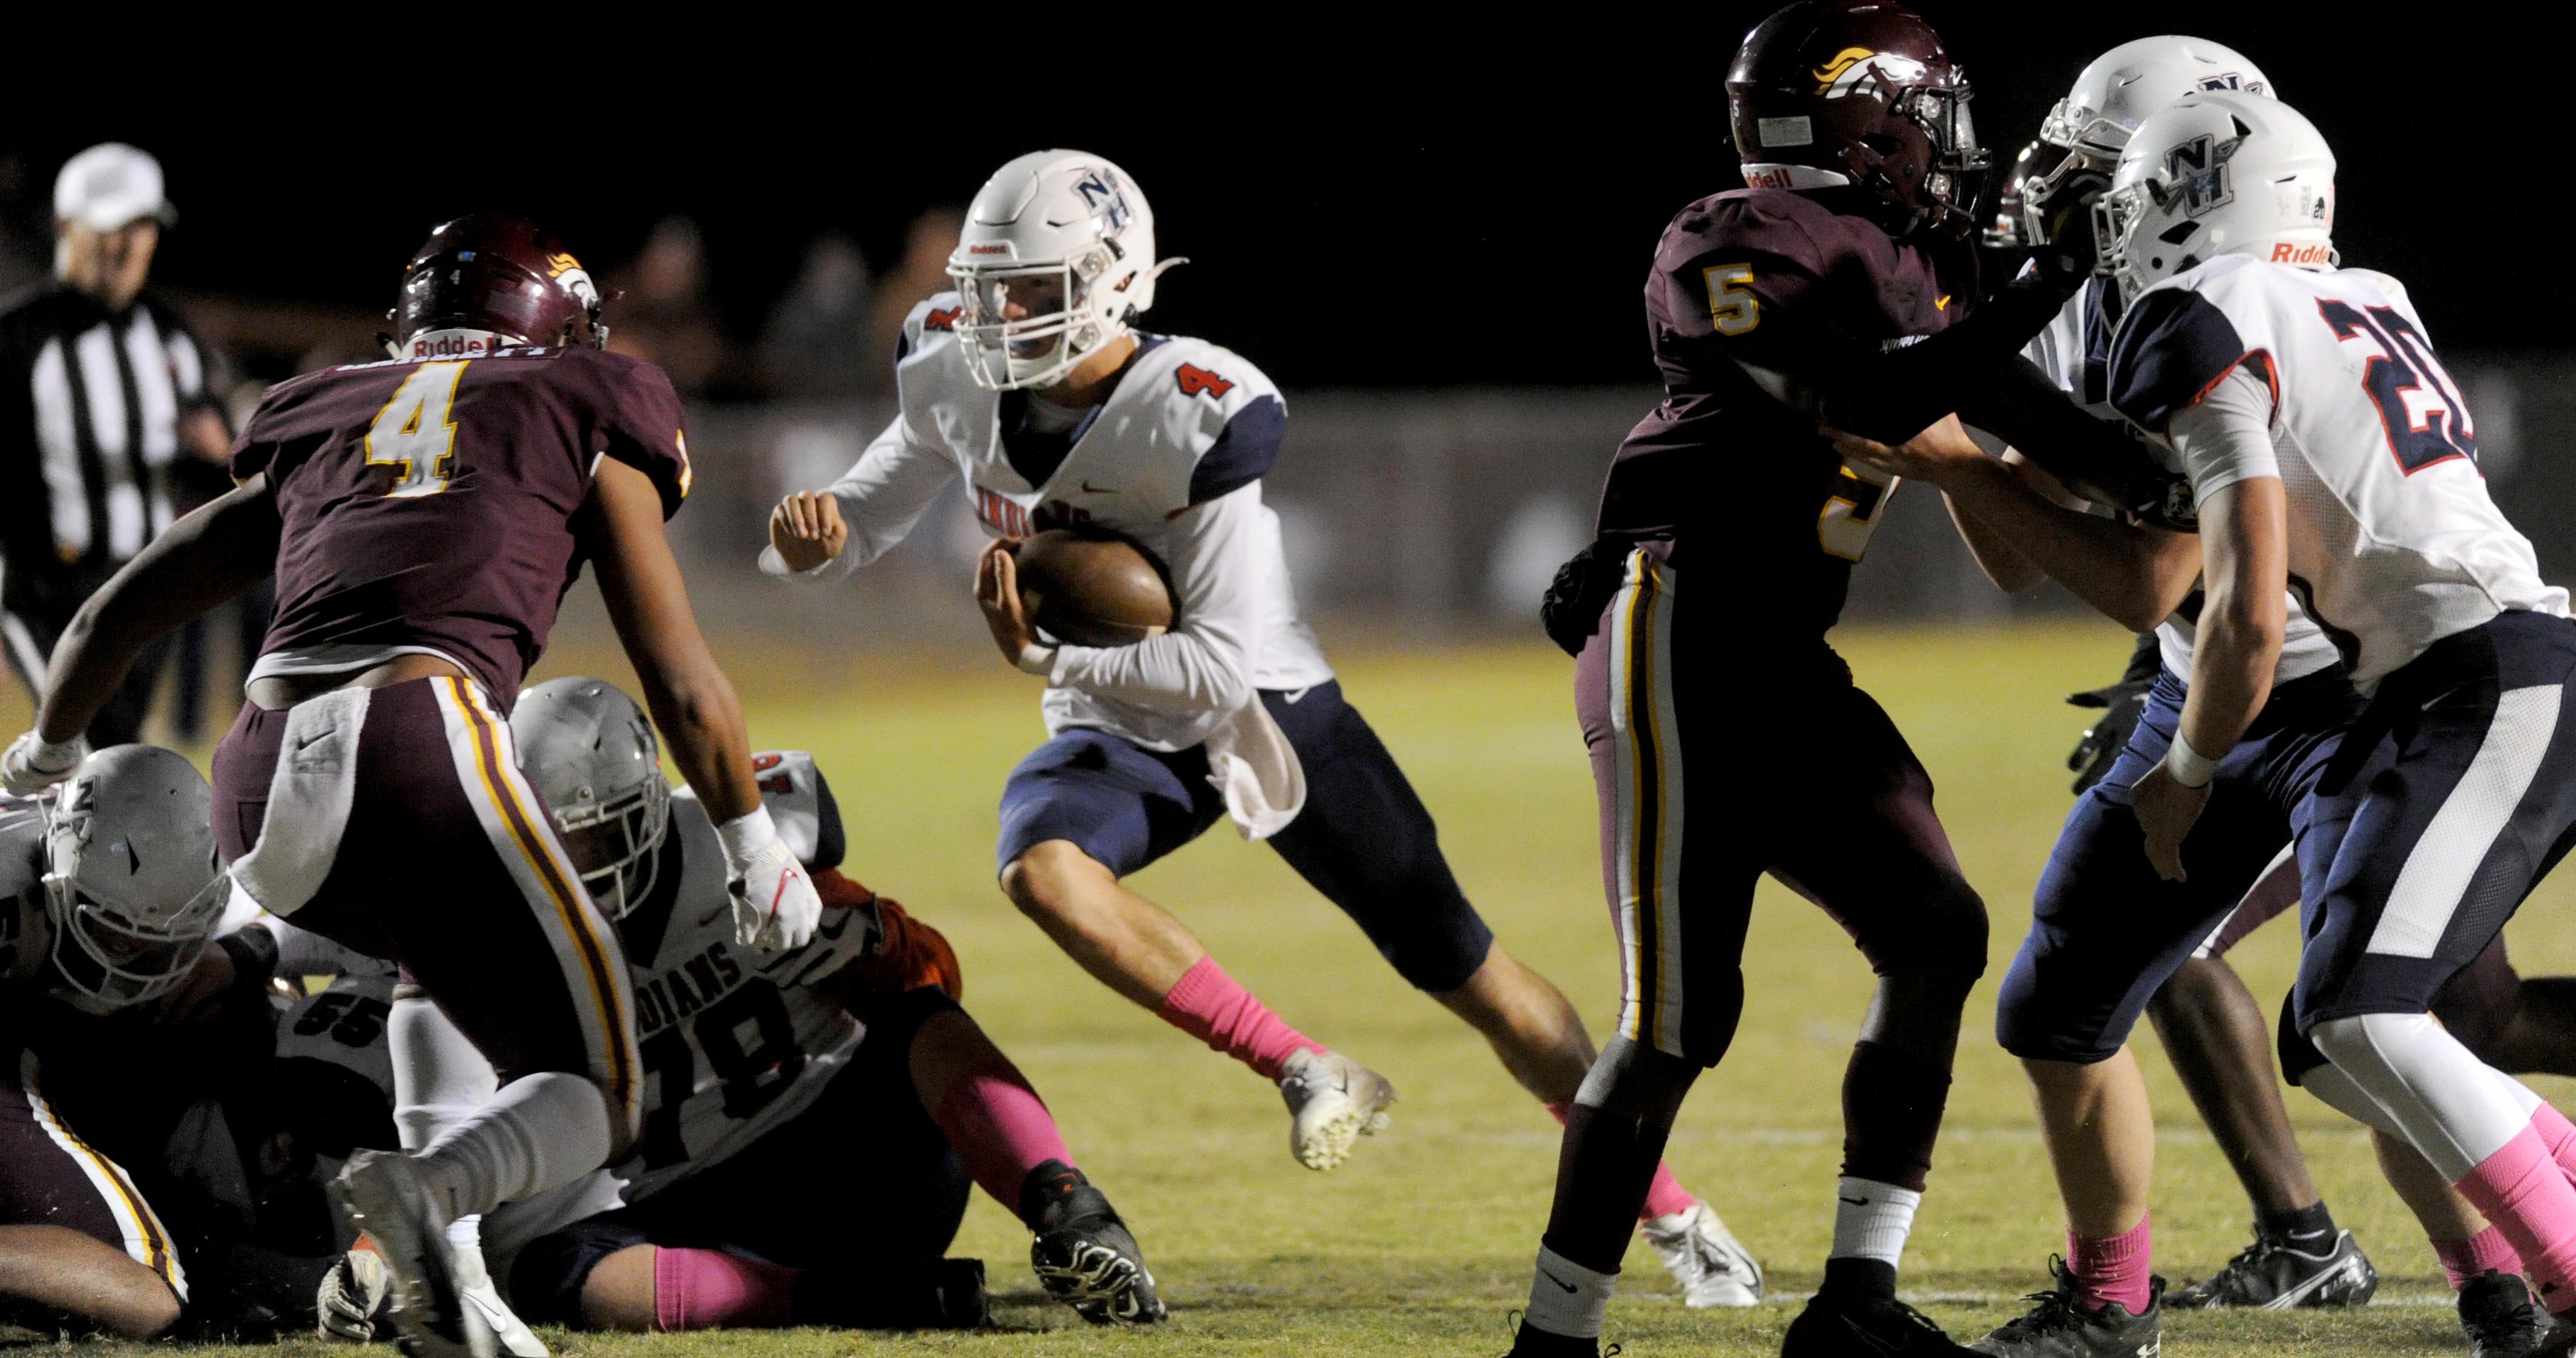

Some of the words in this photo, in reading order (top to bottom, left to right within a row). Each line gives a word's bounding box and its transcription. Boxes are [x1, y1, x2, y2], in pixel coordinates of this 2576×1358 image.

[449, 269, 461, 284] 4
[2271, 243, 2330, 264] Ridde
[1703, 263, 1760, 336] 5
[1174, 362, 1236, 401] 4
[2314, 296, 2484, 478] 20
[364, 360, 472, 499] 4
[640, 977, 805, 1172] 78
